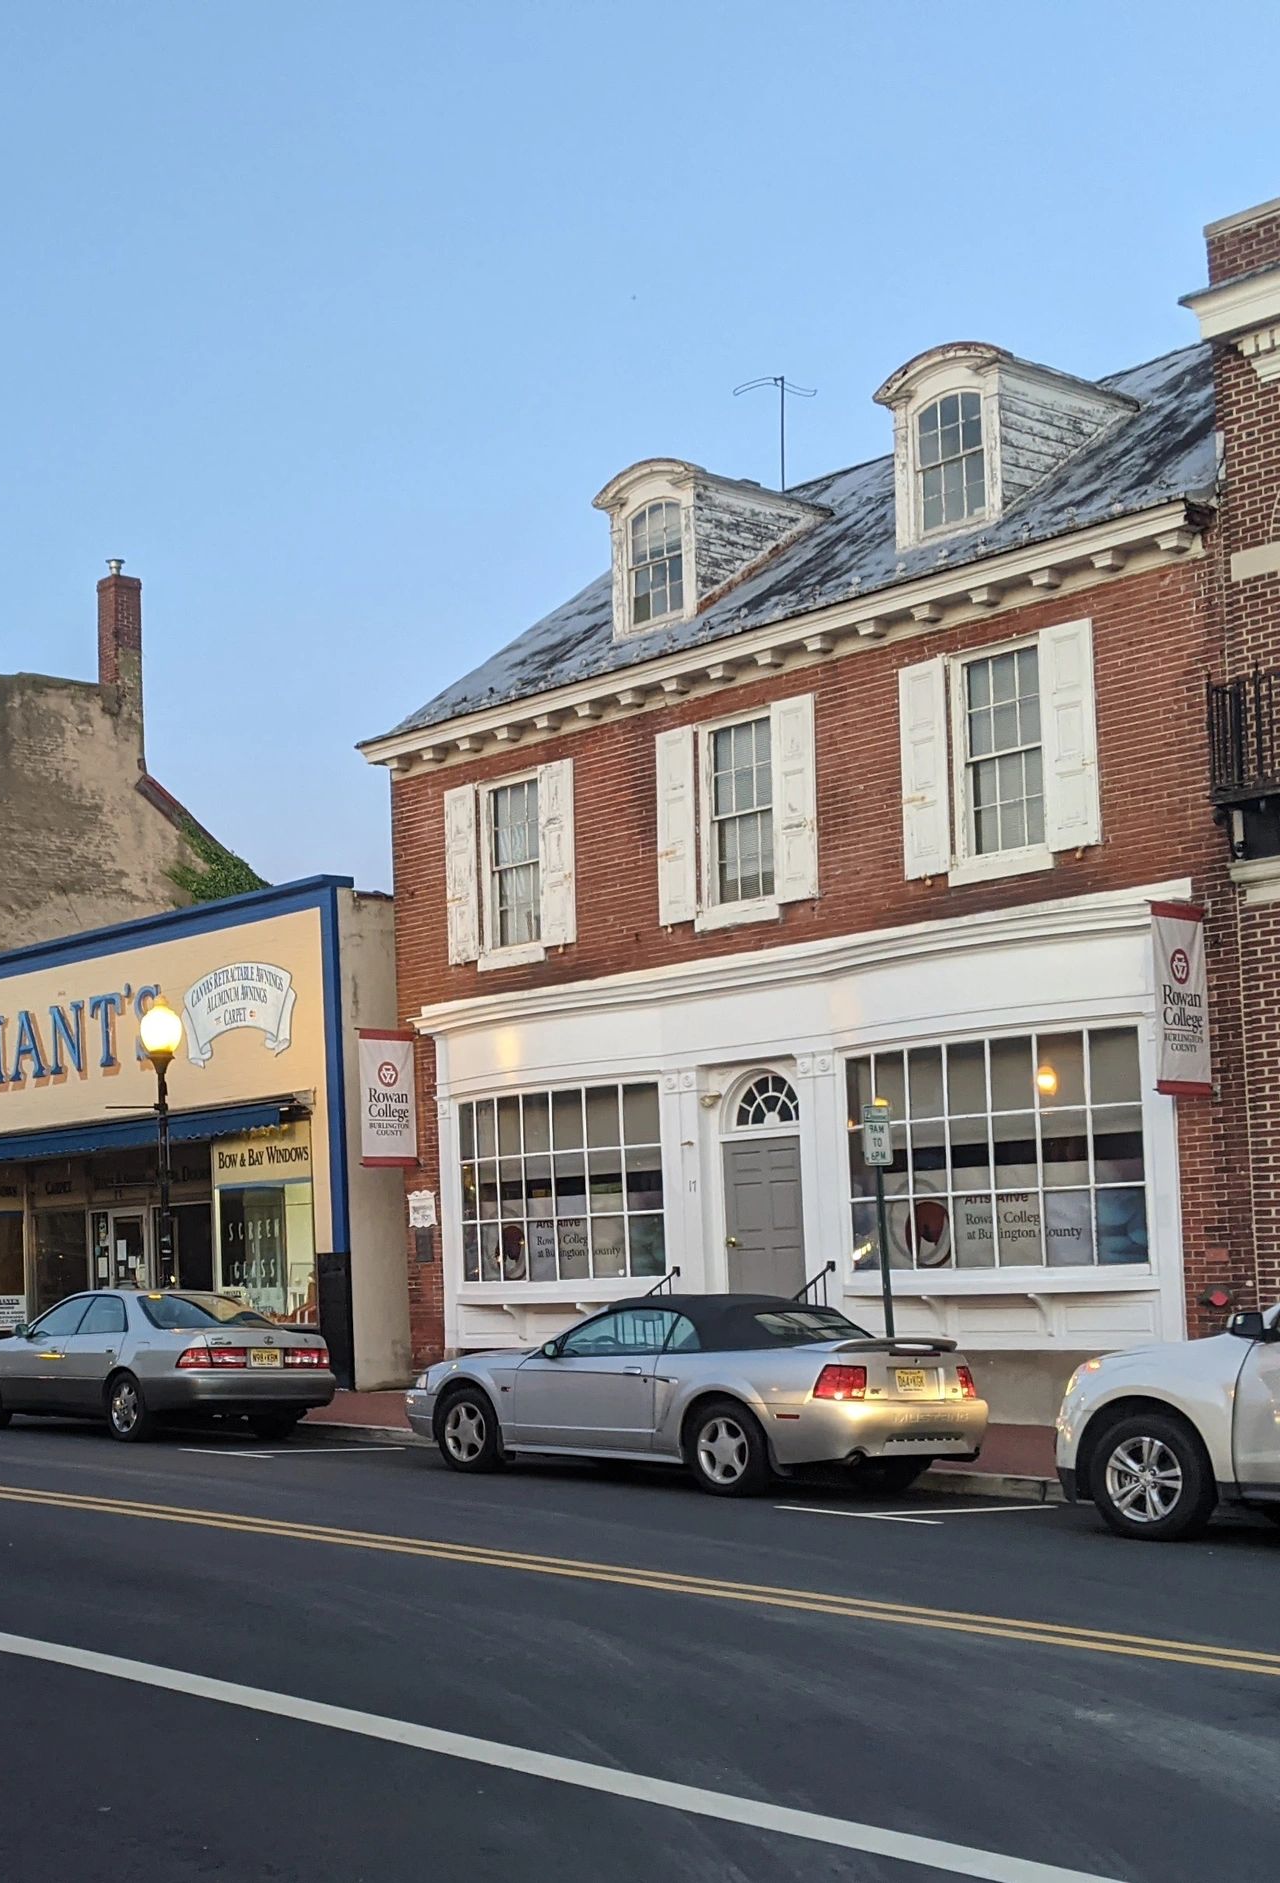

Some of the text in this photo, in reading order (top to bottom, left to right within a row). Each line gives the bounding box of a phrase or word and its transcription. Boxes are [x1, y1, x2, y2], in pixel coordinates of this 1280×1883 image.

[191, 965, 284, 1008] CANVAS RETRACTABLE AWNINGS
[1163, 984, 1202, 1008] Rowan
[207, 985, 268, 1015] ALUMINUM AWNINGS
[223, 1007, 247, 1026] CARPET
[1163, 1007, 1203, 1034] College
[1171, 1043, 1197, 1053] COUNTY
[368, 1087, 409, 1104] Rowan
[368, 1103, 409, 1122] College
[218, 1146, 309, 1169] BOW & BAY WINDOWS
[965, 1211, 1040, 1226] Rowa Colleg
[537, 1234, 588, 1246] Row Colleg
[967, 1230, 976, 1240] at
[978, 1228, 1036, 1242] Buington
[545, 1248, 585, 1260] Buington
[233, 1258, 275, 1279] GLASS
